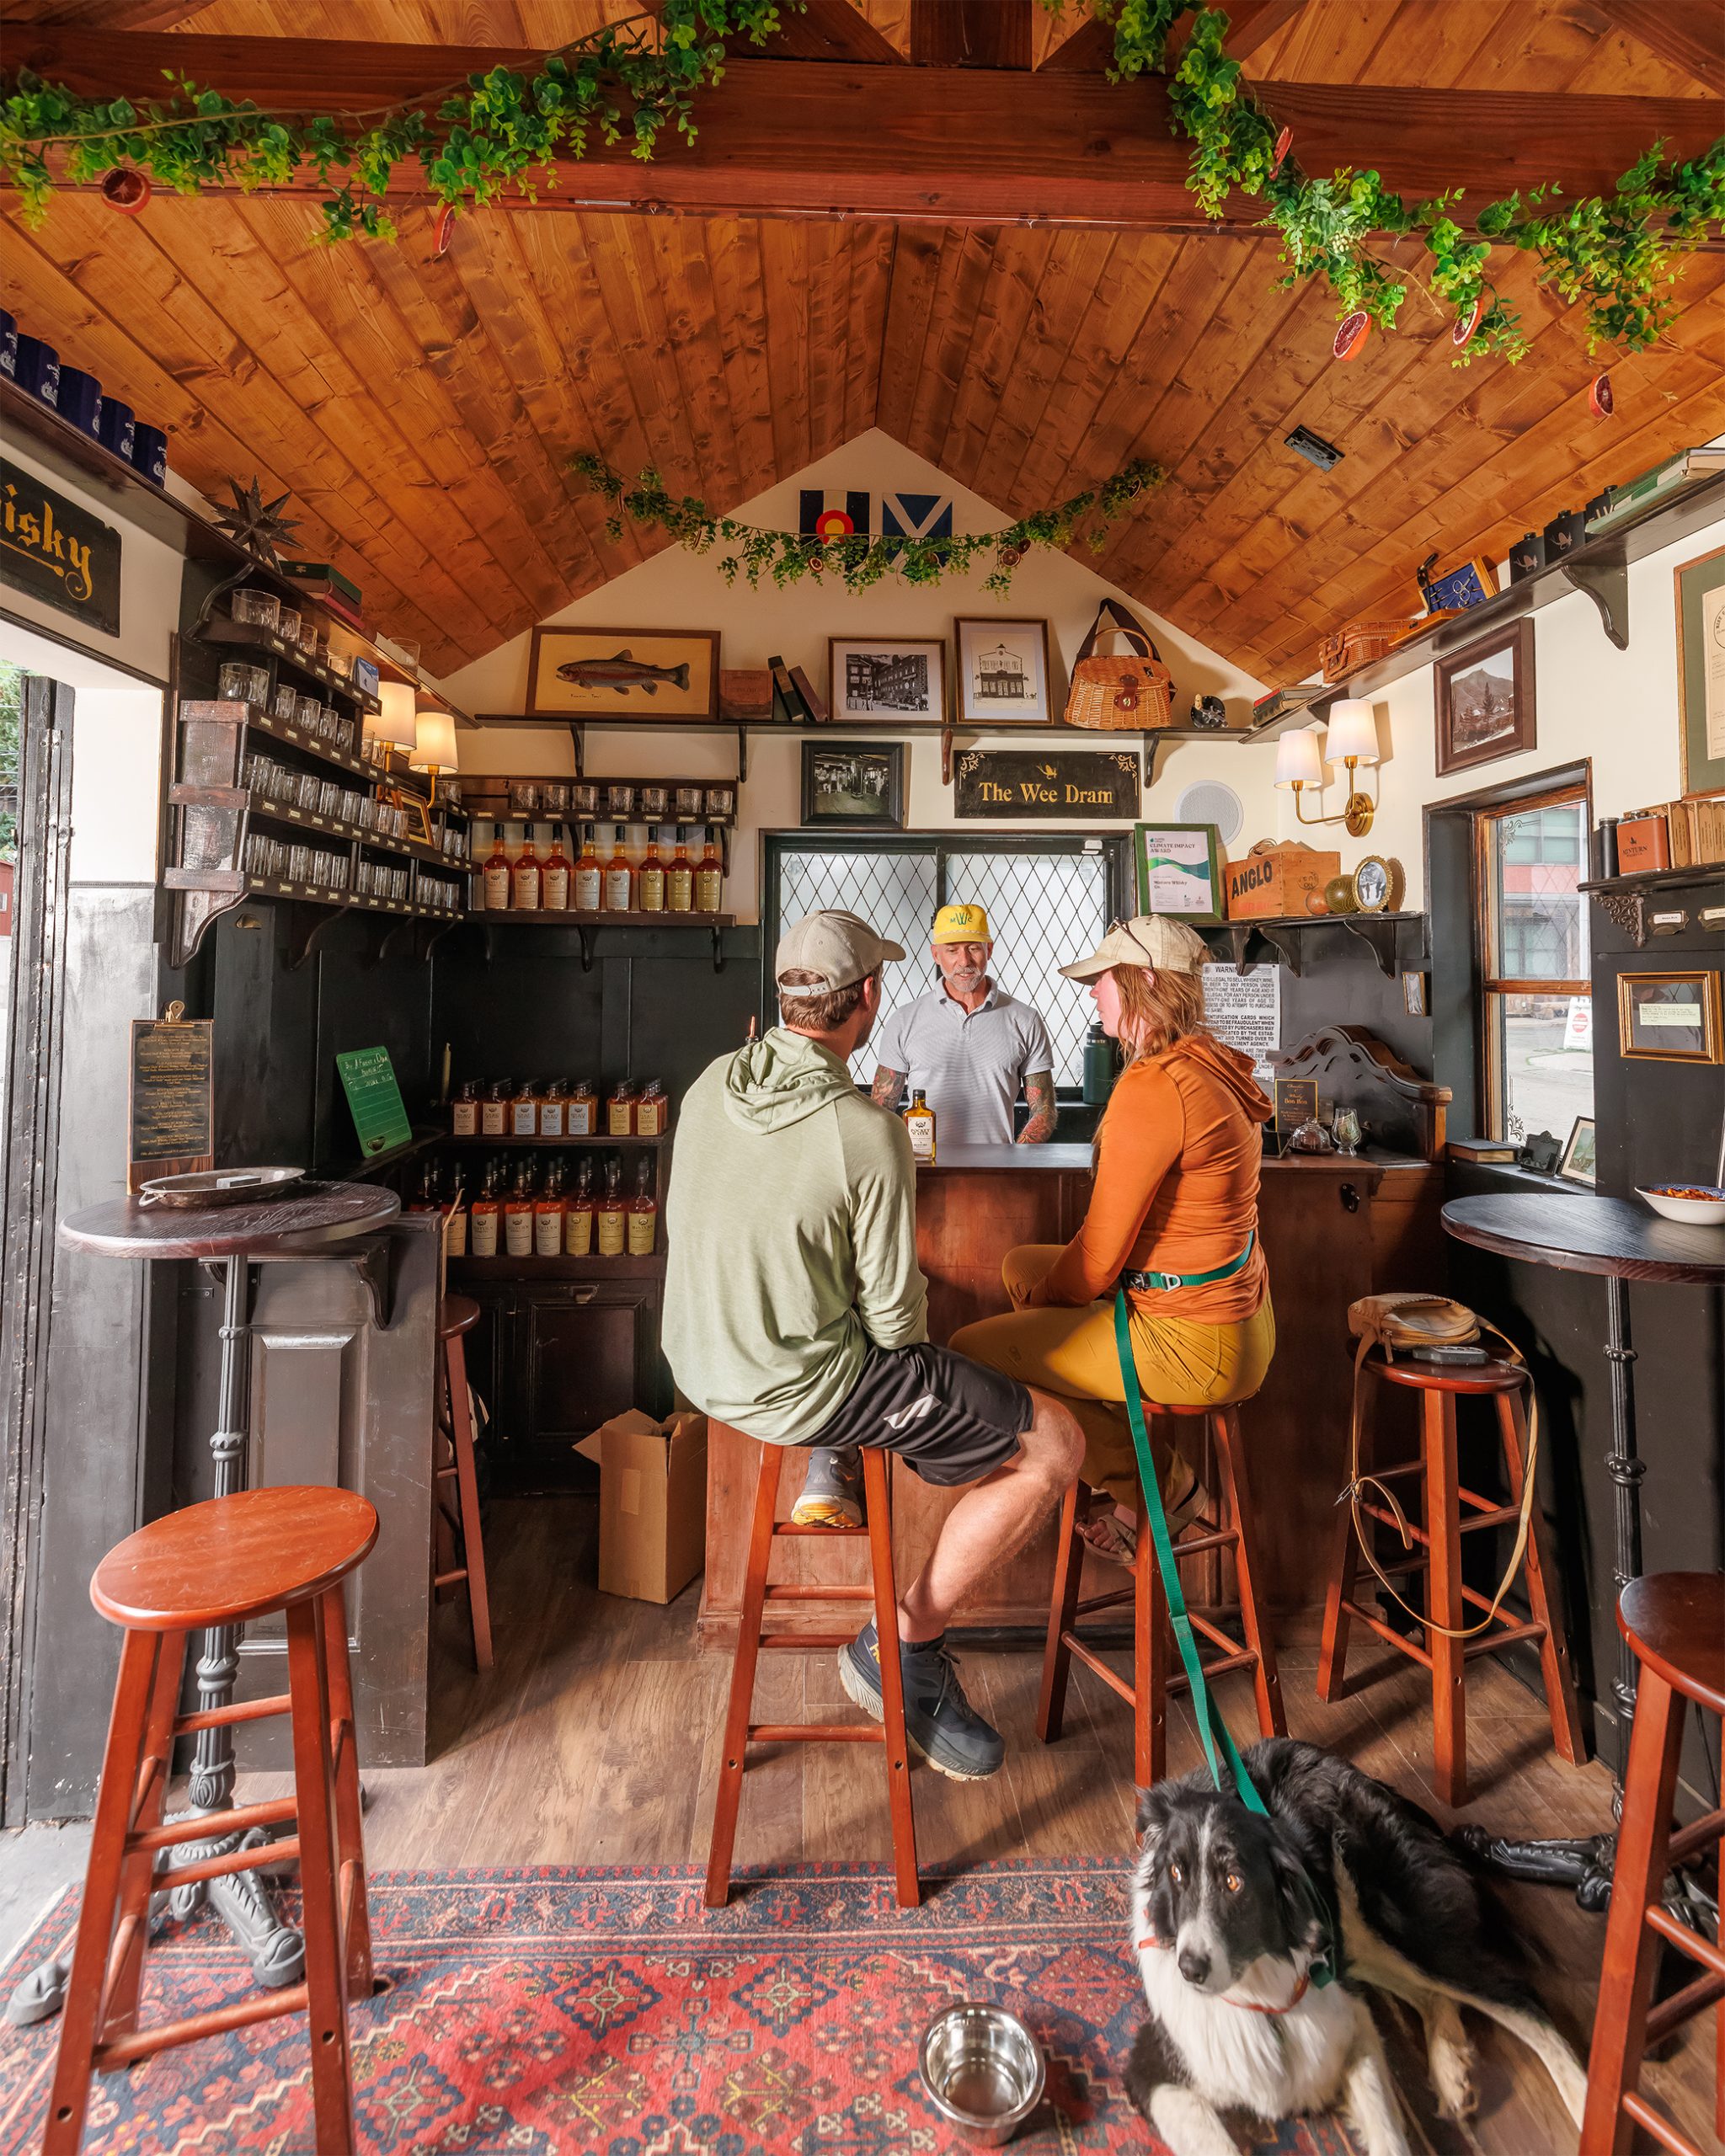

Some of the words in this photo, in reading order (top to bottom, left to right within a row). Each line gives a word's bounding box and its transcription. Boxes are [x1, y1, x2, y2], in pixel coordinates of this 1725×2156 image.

[0, 484, 93, 600] isky
[978, 782, 1012, 802] The
[1020, 782, 1058, 803] Wee
[1065, 783, 1114, 803] Dram
[1231, 861, 1273, 900] ANGLO
